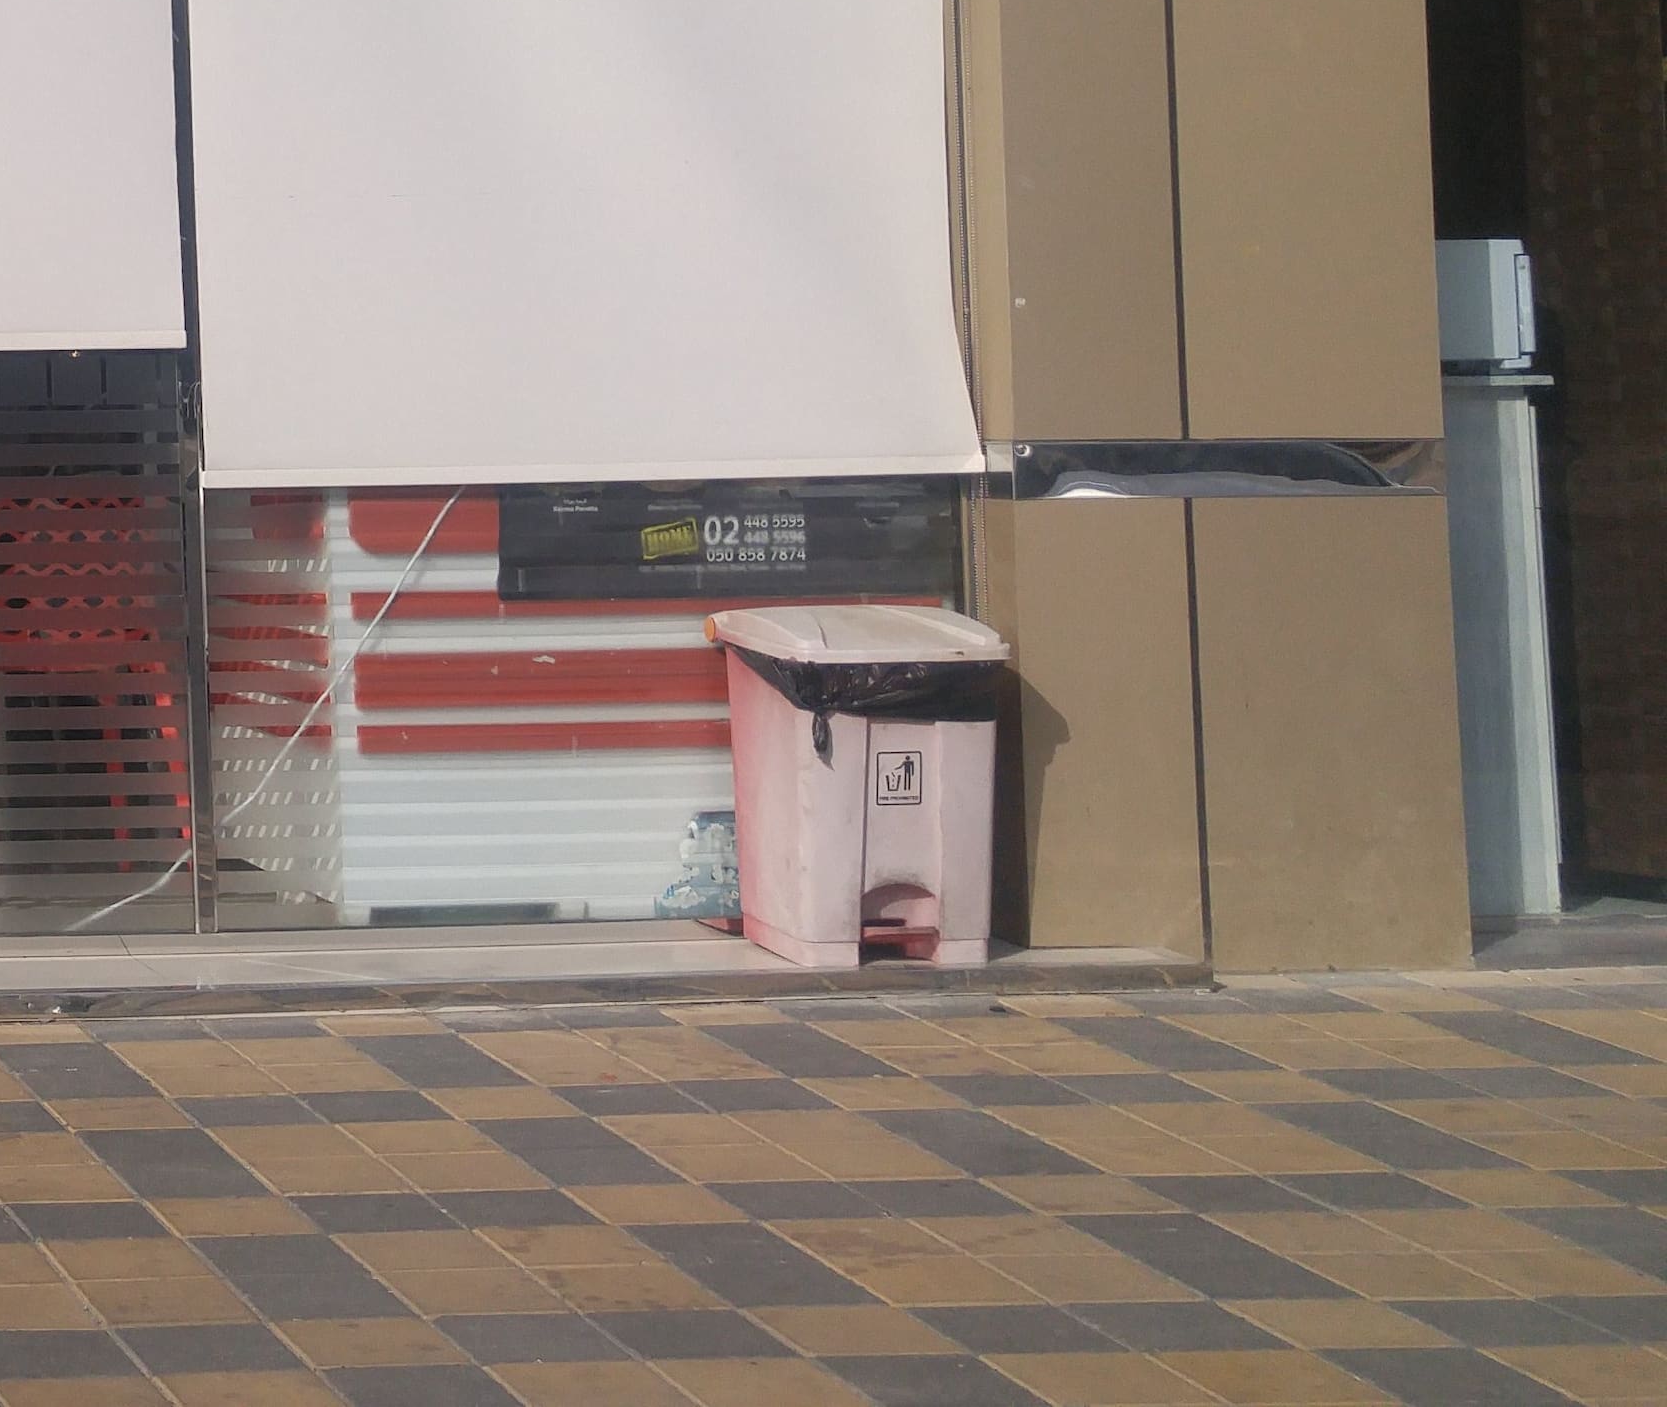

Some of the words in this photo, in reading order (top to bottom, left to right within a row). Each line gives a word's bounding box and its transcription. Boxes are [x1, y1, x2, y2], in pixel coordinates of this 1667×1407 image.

[703, 514, 740, 546] 02
[706, 547, 734, 562] 050
[770, 547, 806, 562] 7874
